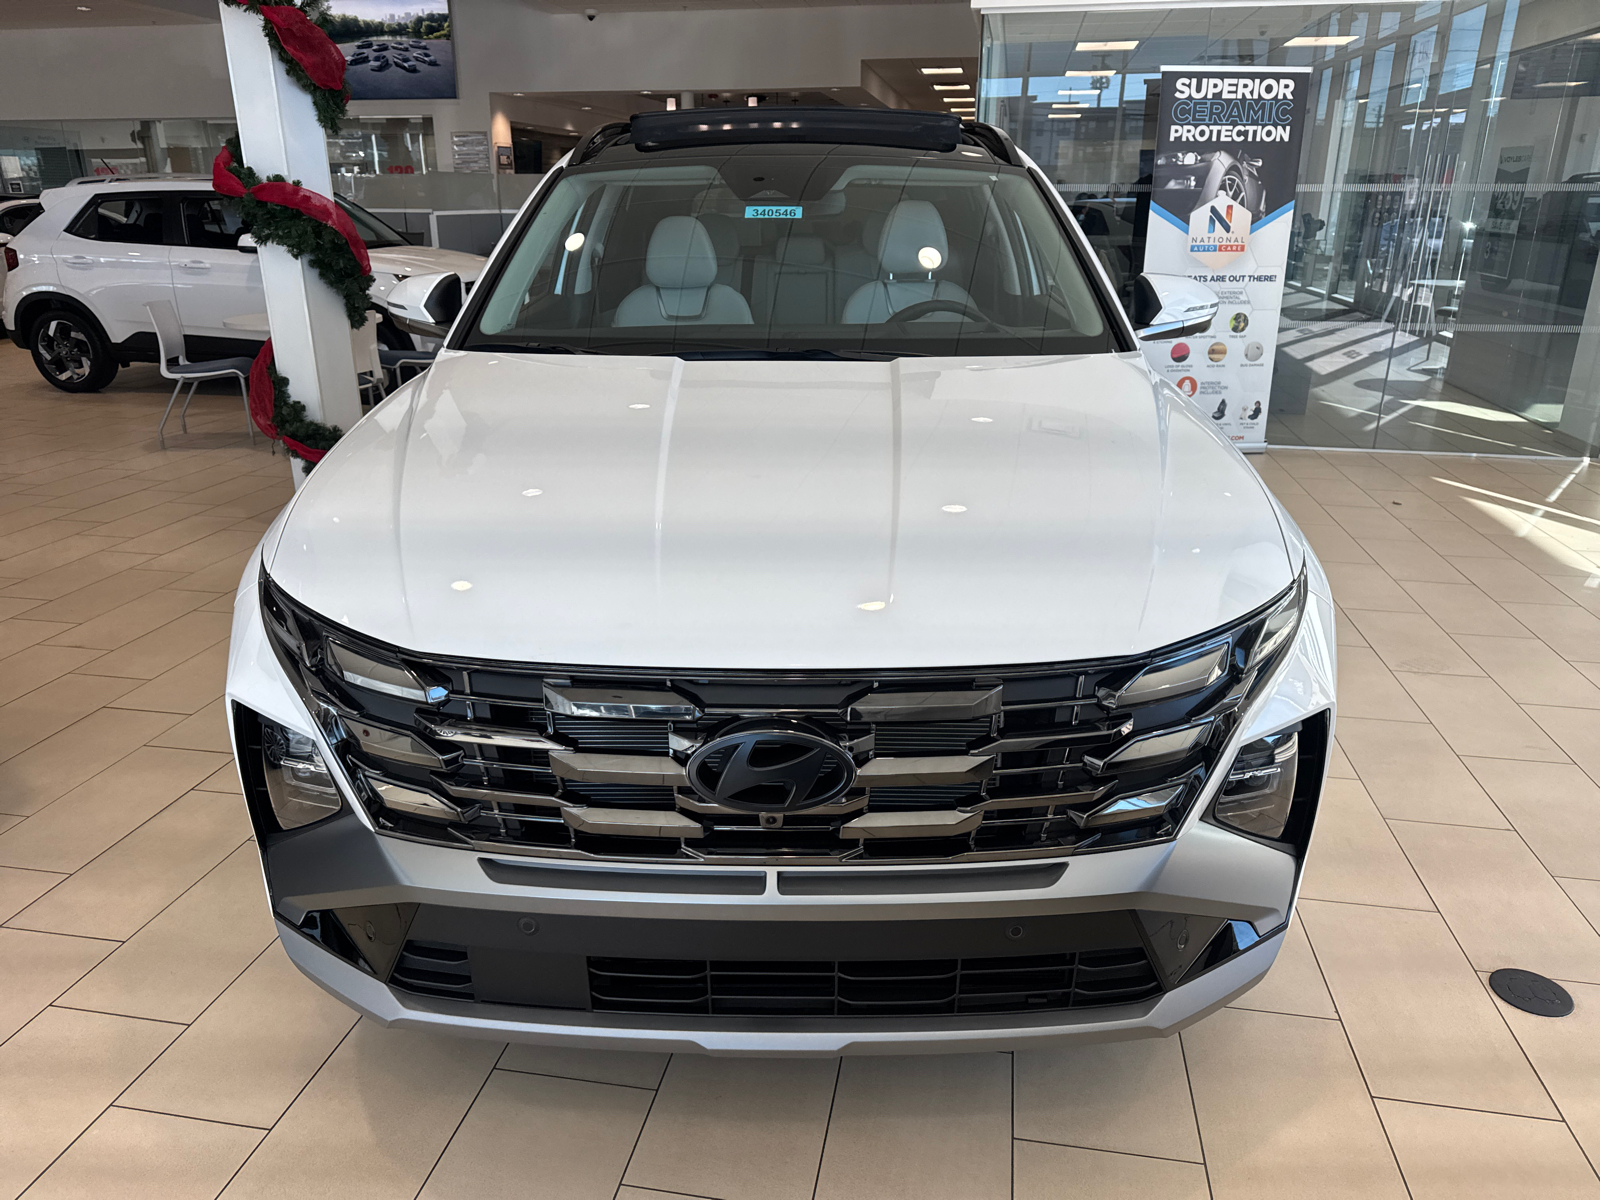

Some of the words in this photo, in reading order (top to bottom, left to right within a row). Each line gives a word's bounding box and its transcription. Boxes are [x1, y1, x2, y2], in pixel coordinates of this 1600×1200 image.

[1174, 78, 1295, 99] SUPERIOR
[1171, 99, 1294, 124] CERAMIC
[1169, 125, 1291, 142] PROTECTION
[752, 208, 796, 217] 340546
[1191, 236, 1245, 244] NATIONAL
